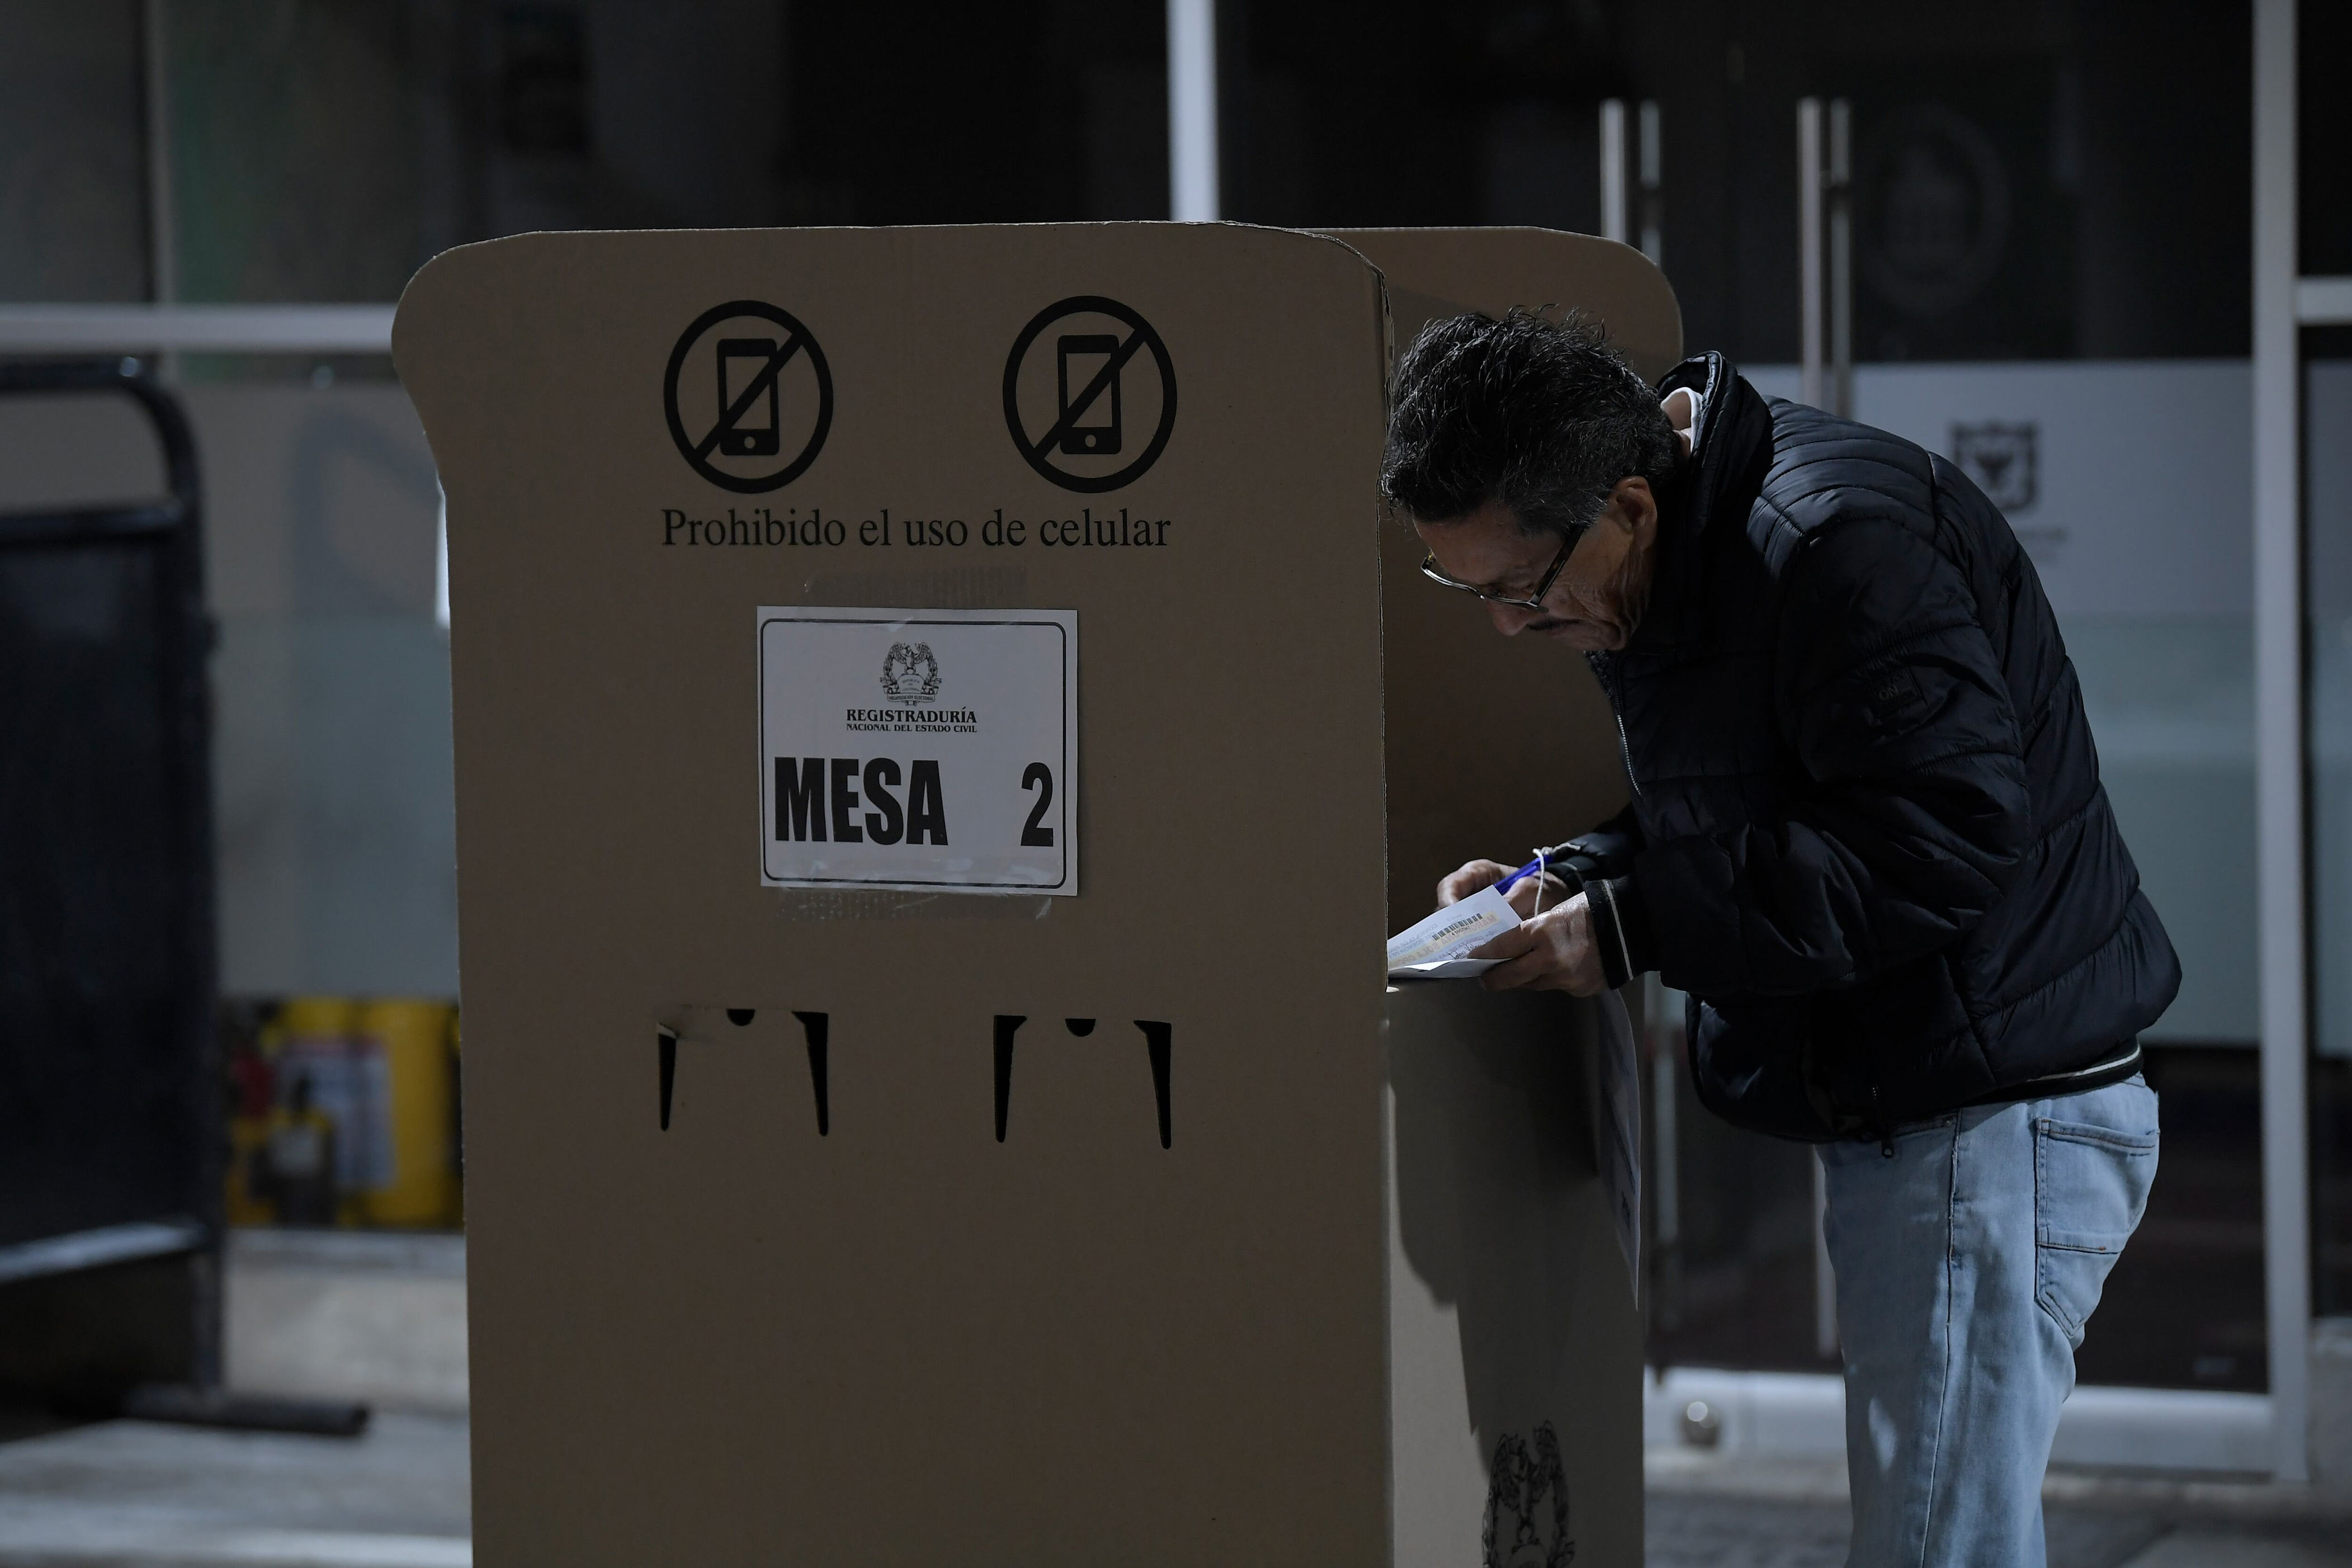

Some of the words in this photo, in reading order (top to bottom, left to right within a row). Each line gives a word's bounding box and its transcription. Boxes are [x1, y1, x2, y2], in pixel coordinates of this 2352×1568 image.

[662, 508, 846, 547] Prohibido
[859, 508, 892, 546] el
[904, 520, 968, 546] uso
[982, 508, 1027, 546] de
[1040, 508, 1171, 546] celular
[847, 706, 977, 723] REGISTRADURÍA
[774, 757, 948, 846] MESA
[1021, 762, 1054, 847] 2
